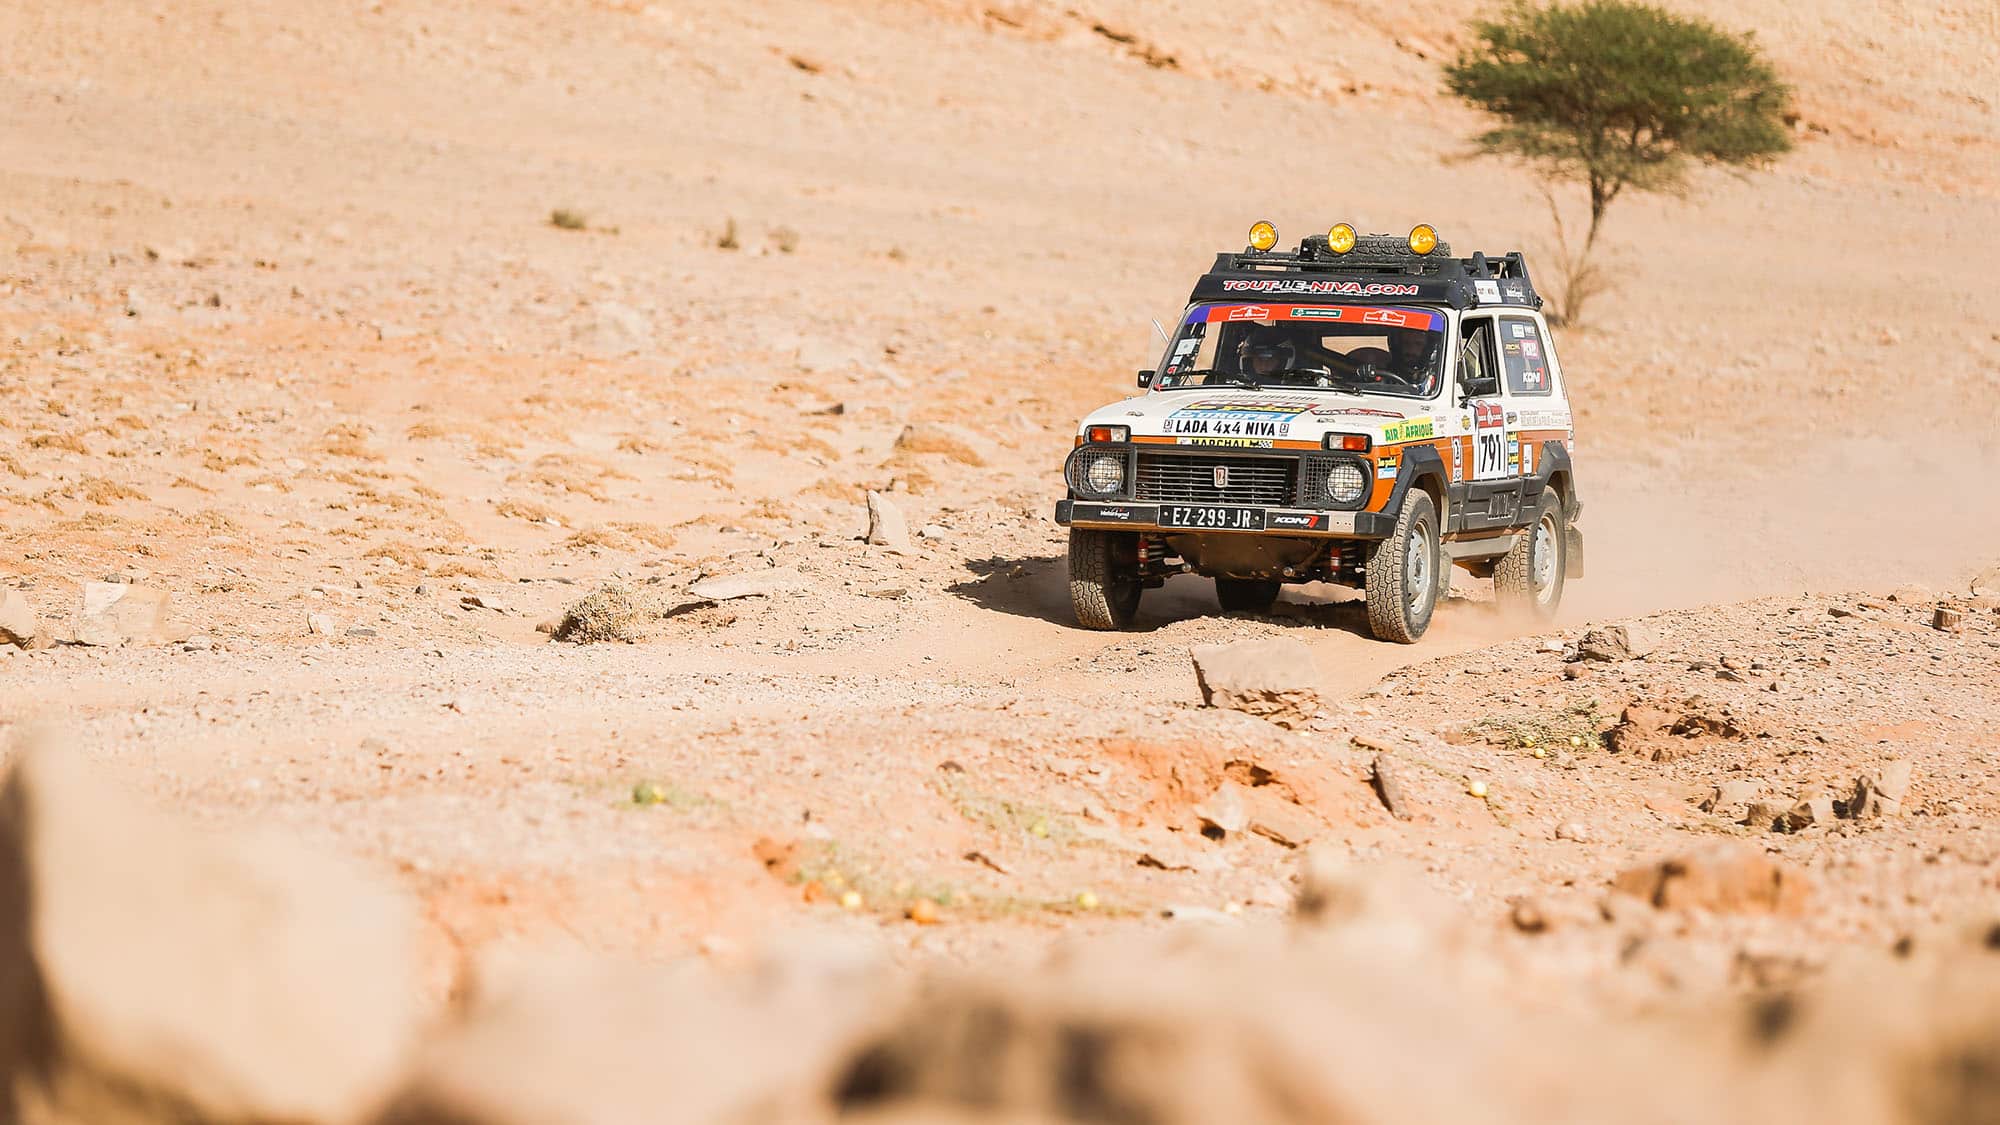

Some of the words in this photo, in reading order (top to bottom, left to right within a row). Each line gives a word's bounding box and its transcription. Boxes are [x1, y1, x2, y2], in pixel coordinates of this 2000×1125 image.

[1175, 420, 1208, 433] LADA
[1213, 421, 1241, 434] 4x4
[1245, 422, 1275, 436] NIVA
[1385, 428, 1399, 442] AIR
[1405, 423, 1434, 438] AFRIQUE
[1480, 433, 1501, 473] 791
[1173, 507, 1251, 528] EZ-299-JR
[1274, 515, 1310, 526] KONI
